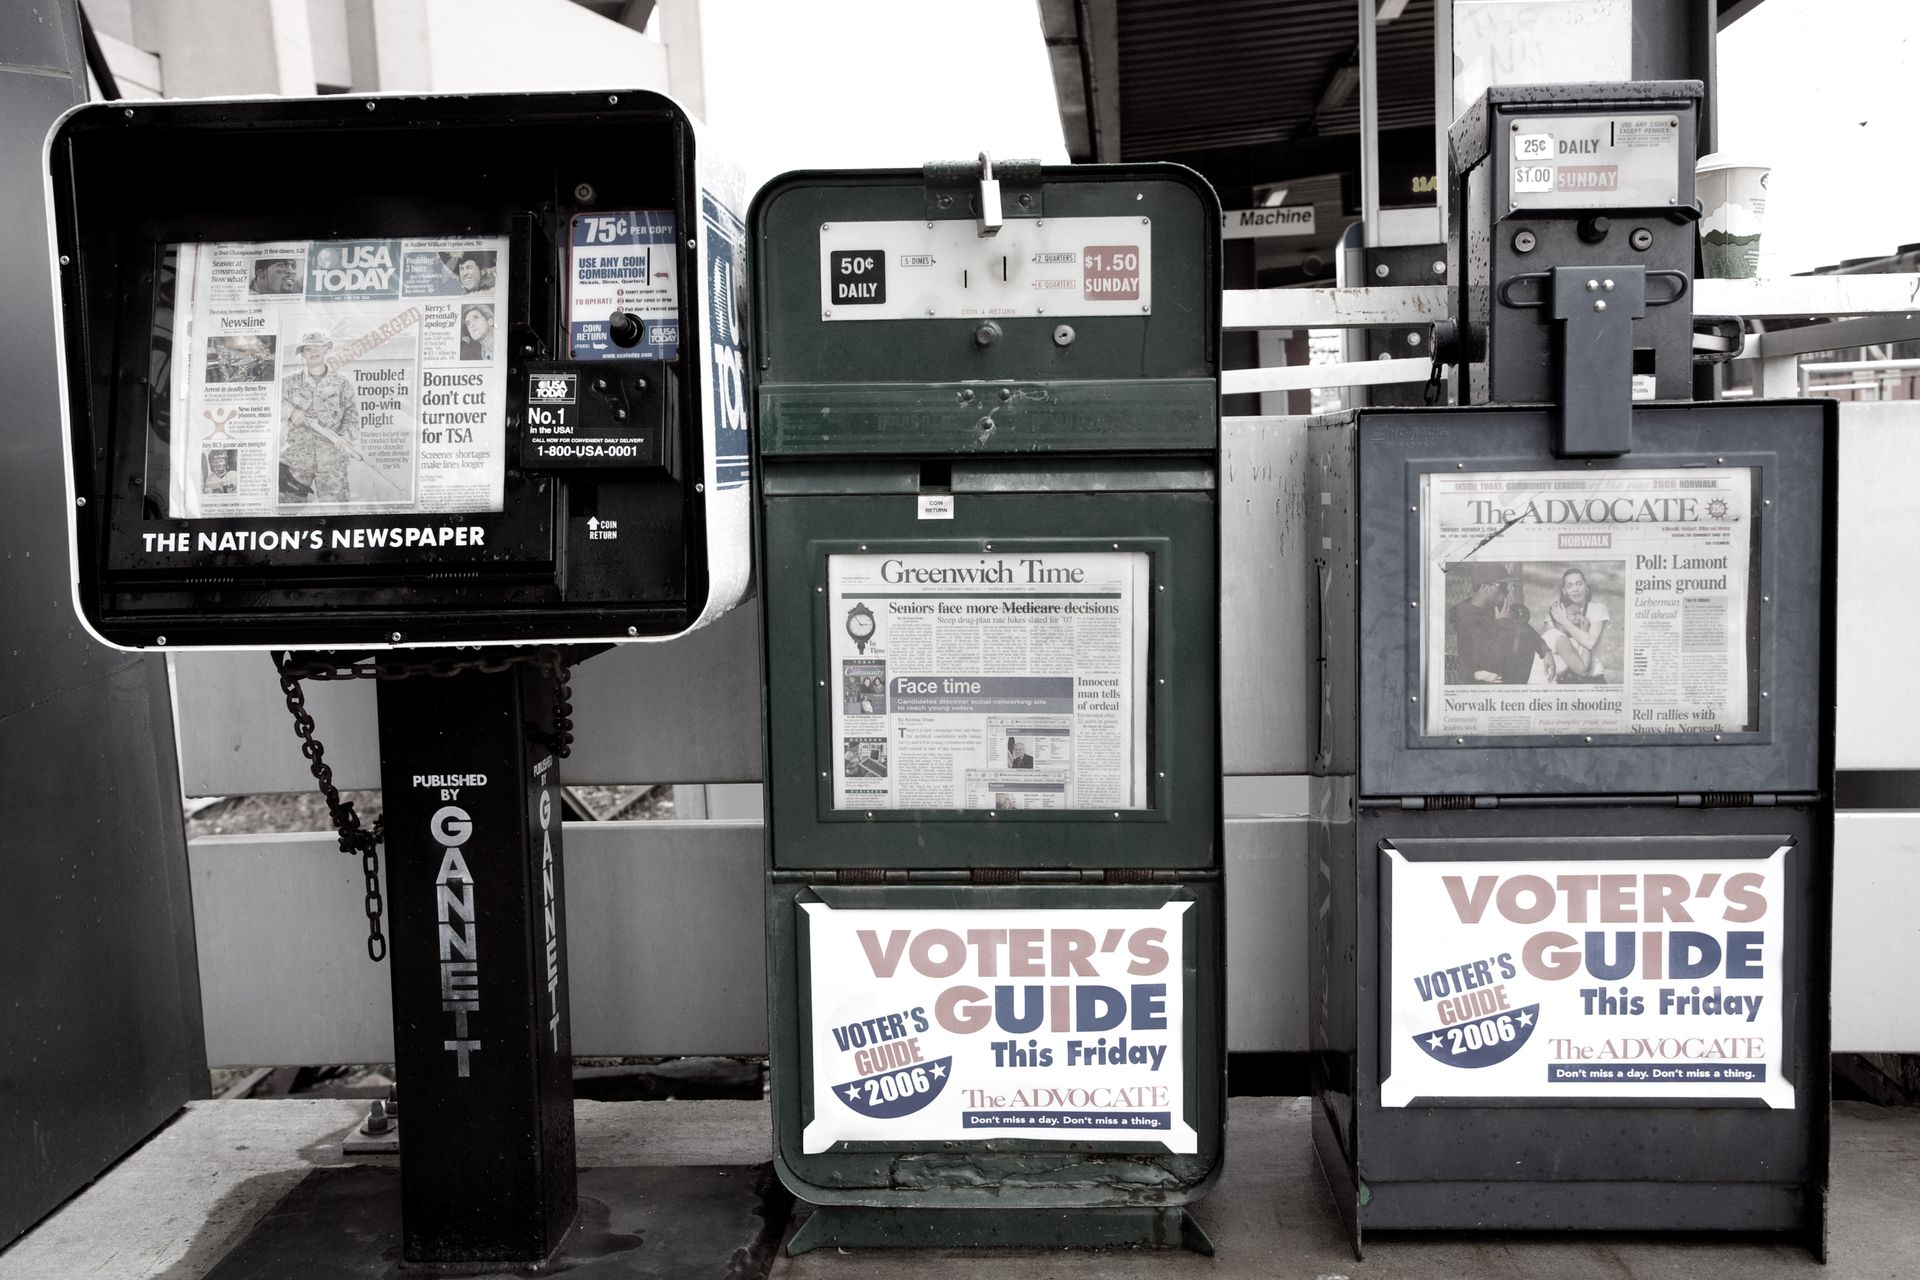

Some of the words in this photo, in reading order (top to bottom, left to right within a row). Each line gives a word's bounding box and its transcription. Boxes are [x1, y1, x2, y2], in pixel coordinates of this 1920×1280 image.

[1524, 139, 1546, 153] 25¢
[1559, 139, 1600, 155] DAILY
[1517, 168, 1550, 183] $1.00
[1558, 170, 1617, 188] SUNDAY
[1240, 209, 1312, 226] Machine
[585, 217, 627, 243] 75¢
[630, 226, 647, 235] PER
[649, 225, 673, 234] COPY
[341, 246, 393, 268] USA
[579, 258, 597, 268] USE
[600, 257, 619, 267] ANY
[622, 256, 646, 267] COIN
[911, 256, 930, 265] DIMES
[1045, 254, 1074, 263] QUARTERS
[1084, 253, 1137, 271] $1.50
[841, 257, 874, 274] 50¢
[312, 268, 395, 291] TODAY
[579, 268, 646, 280] COMBINATION
[839, 283, 877, 298] DAILY
[1045, 280, 1074, 289] QUARTERS
[1085, 278, 1139, 293] SUNDAY
[425, 304, 445, 313] Kerry:
[221, 317, 265, 328] Newsline
[425, 312, 458, 321] personally
[577, 332, 607, 340] RETURN
[583, 325, 602, 333] COIN
[326, 306, 422, 371] DISCHARGED
[650, 335, 677, 343] TODAY
[354, 369, 405, 382] Troubled
[423, 371, 483, 387] Bonuses
[358, 384, 395, 399] troops
[398, 383, 409, 396] in
[422, 390, 459, 406] don't
[462, 390, 486, 405] cut
[536, 388, 568, 398] TODAY
[361, 398, 401, 411] no-win
[361, 413, 394, 428] plight
[422, 410, 487, 425] turnover
[528, 407, 565, 425] No.1
[422, 428, 442, 444] for
[446, 428, 473, 443] TSA
[530, 426, 537, 434] in
[539, 426, 552, 434] the
[553, 426, 574, 434] USA!
[421, 450, 454, 460] Screener
[455, 450, 490, 461] shortages
[537, 445, 637, 457] 1-800-USA-0001
[421, 460, 441, 469] make
[443, 460, 460, 469] lines
[461, 460, 485, 470] longer
[1467, 500, 1516, 525] The
[1520, 497, 1699, 524] ADVOCATE
[600, 520, 617, 529] COIN
[143, 533, 190, 552] THE
[198, 530, 324, 552] NATION'S
[331, 526, 485, 549] NEWSPAPER
[589, 531, 617, 540] RETURN
[1561, 534, 1610, 548] NORWALK
[1635, 554, 1667, 570] Poll:
[1672, 554, 1727, 570] Lamont
[880, 559, 1013, 584] Greenwich
[1635, 575, 1672, 594] gains
[1675, 575, 1727, 594] ground
[889, 602, 934, 615] Seniors
[938, 602, 962, 614] face
[966, 604, 998, 614] more
[1002, 601, 1061, 614] Medicare
[1064, 601, 1119, 614] decisions
[1634, 597, 1679, 607] Lieberman
[937, 616, 956, 625] Steep
[958, 616, 991, 625] drug-plan
[1007, 616, 1026, 624] hikes
[1049, 616, 1059, 624] for
[1635, 609, 1649, 619] still
[897, 678, 938, 694] Face
[943, 678, 981, 694] time
[1078, 677, 1119, 687] Innocent
[1078, 690, 1099, 699] man
[1102, 689, 1121, 699] tells
[1077, 701, 1087, 711] of
[1090, 701, 1120, 711] ordeal
[1444, 699, 1496, 712] Norwalk
[1500, 699, 1526, 712] teen
[1529, 698, 1552, 712] dies
[1556, 698, 1568, 711] in
[1571, 698, 1622, 714] shooting
[1633, 709, 1654, 720] Rell
[1656, 709, 1689, 720] rallies
[1692, 709, 1715, 720] with
[1679, 724, 1724, 733] Norwalk
[533, 755, 553, 778] PUBLISHED
[413, 774, 487, 788] PUBLISHED
[441, 789, 459, 801] BY
[1441, 872, 1768, 924] VOTER'S
[539, 789, 560, 1054] GANNETT
[430, 805, 481, 1077] GANNETT
[856, 927, 1170, 979] VOTER'S
[1522, 931, 1764, 982] GUIDE
[1414, 952, 1517, 1002] VOTER'S
[935, 983, 1168, 1035] GUIDE
[1437, 984, 1512, 1026] GUIDE
[1579, 986, 1646, 1016] This
[1659, 986, 1764, 1023] Friday
[832, 1006, 929, 1052] VOTER'S
[1447, 1015, 1517, 1056] 2006
[990, 1039, 1054, 1068] This
[1068, 1037, 1168, 1071] Friday
[1548, 1038, 1594, 1060] The
[1598, 1037, 1766, 1060] ADVOCATE
[854, 1037, 924, 1077] GUIDE
[1590, 1068, 1614, 1078] miss
[1616, 1070, 1624, 1078] a
[1627, 1068, 1649, 1080] day.
[1686, 1068, 1711, 1078] miss
[1713, 1070, 1721, 1078] a
[1723, 1068, 1756, 1080] thing.
[864, 1067, 930, 1107] 2006
[961, 1089, 1006, 1108] The
[1009, 1086, 1170, 1108] ADVOCATE
[1003, 1115, 1026, 1124] miss
[1038, 1116, 1060, 1126] day.
[1095, 1116, 1118, 1125] miss
[1131, 1117, 1162, 1127] thing.
